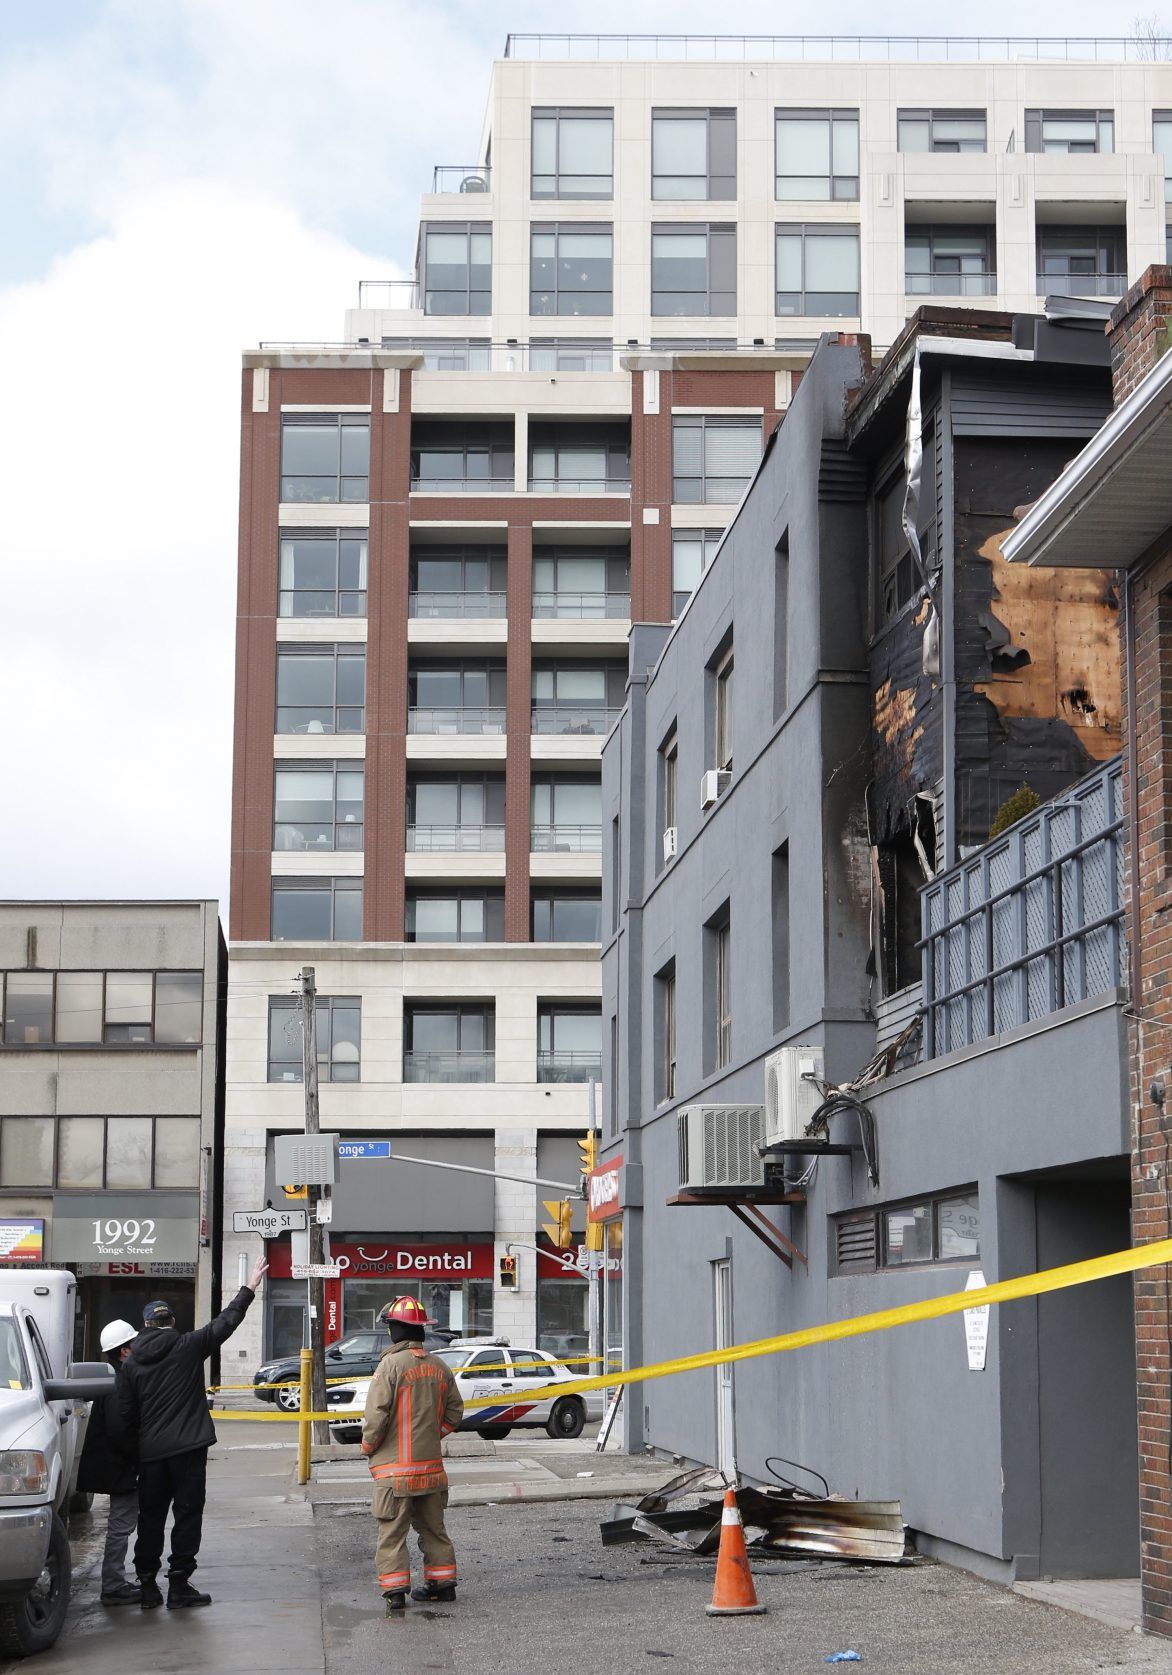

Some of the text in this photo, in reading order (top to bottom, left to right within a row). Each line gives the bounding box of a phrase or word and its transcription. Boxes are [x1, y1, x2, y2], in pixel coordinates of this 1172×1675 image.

[338, 1145, 365, 1157] onge
[246, 1214, 291, 1230] Yonge St
[92, 1219, 157, 1245] 1992
[97, 1245, 154, 1256] Yonge Street
[108, 1262, 145, 1275] ESL
[352, 1261, 395, 1274] yonge
[396, 1251, 472, 1270] Dental
[402, 1364, 444, 1383] TORONTO
